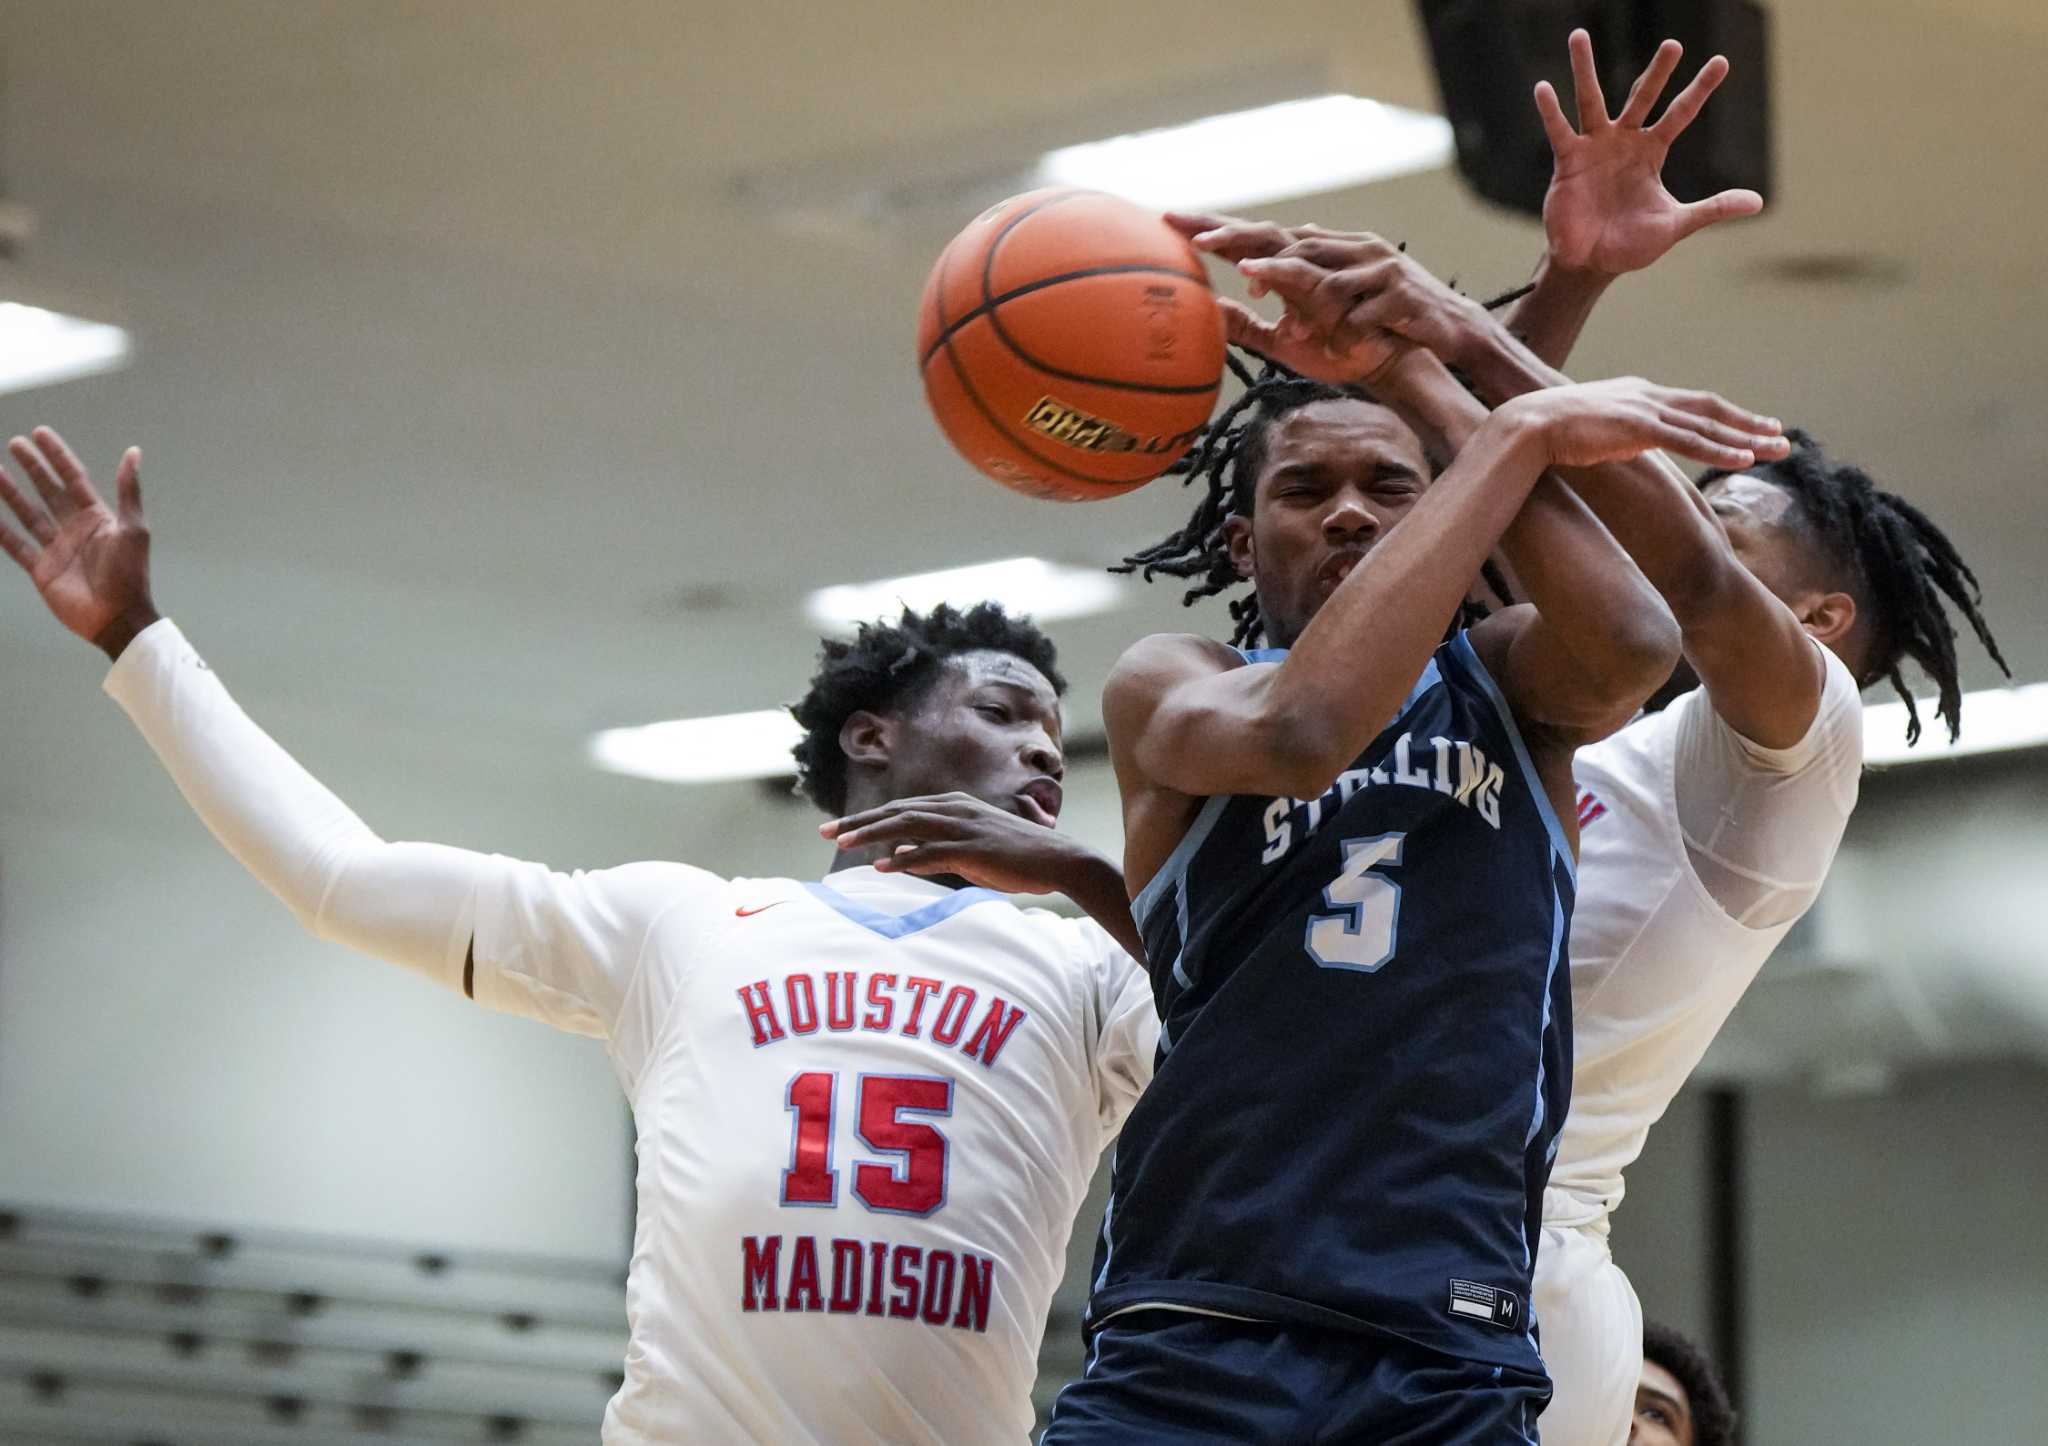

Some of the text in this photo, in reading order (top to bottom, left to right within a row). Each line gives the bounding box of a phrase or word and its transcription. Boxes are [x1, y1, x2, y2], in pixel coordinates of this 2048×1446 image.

[1261, 732, 1504, 865] STLING
[1304, 832, 1406, 972] 5
[736, 971, 1027, 1070] HOUSTON
[779, 1071, 955, 1219] 15
[742, 1235, 993, 1332] MADISON
[1501, 1299, 1513, 1318] M
